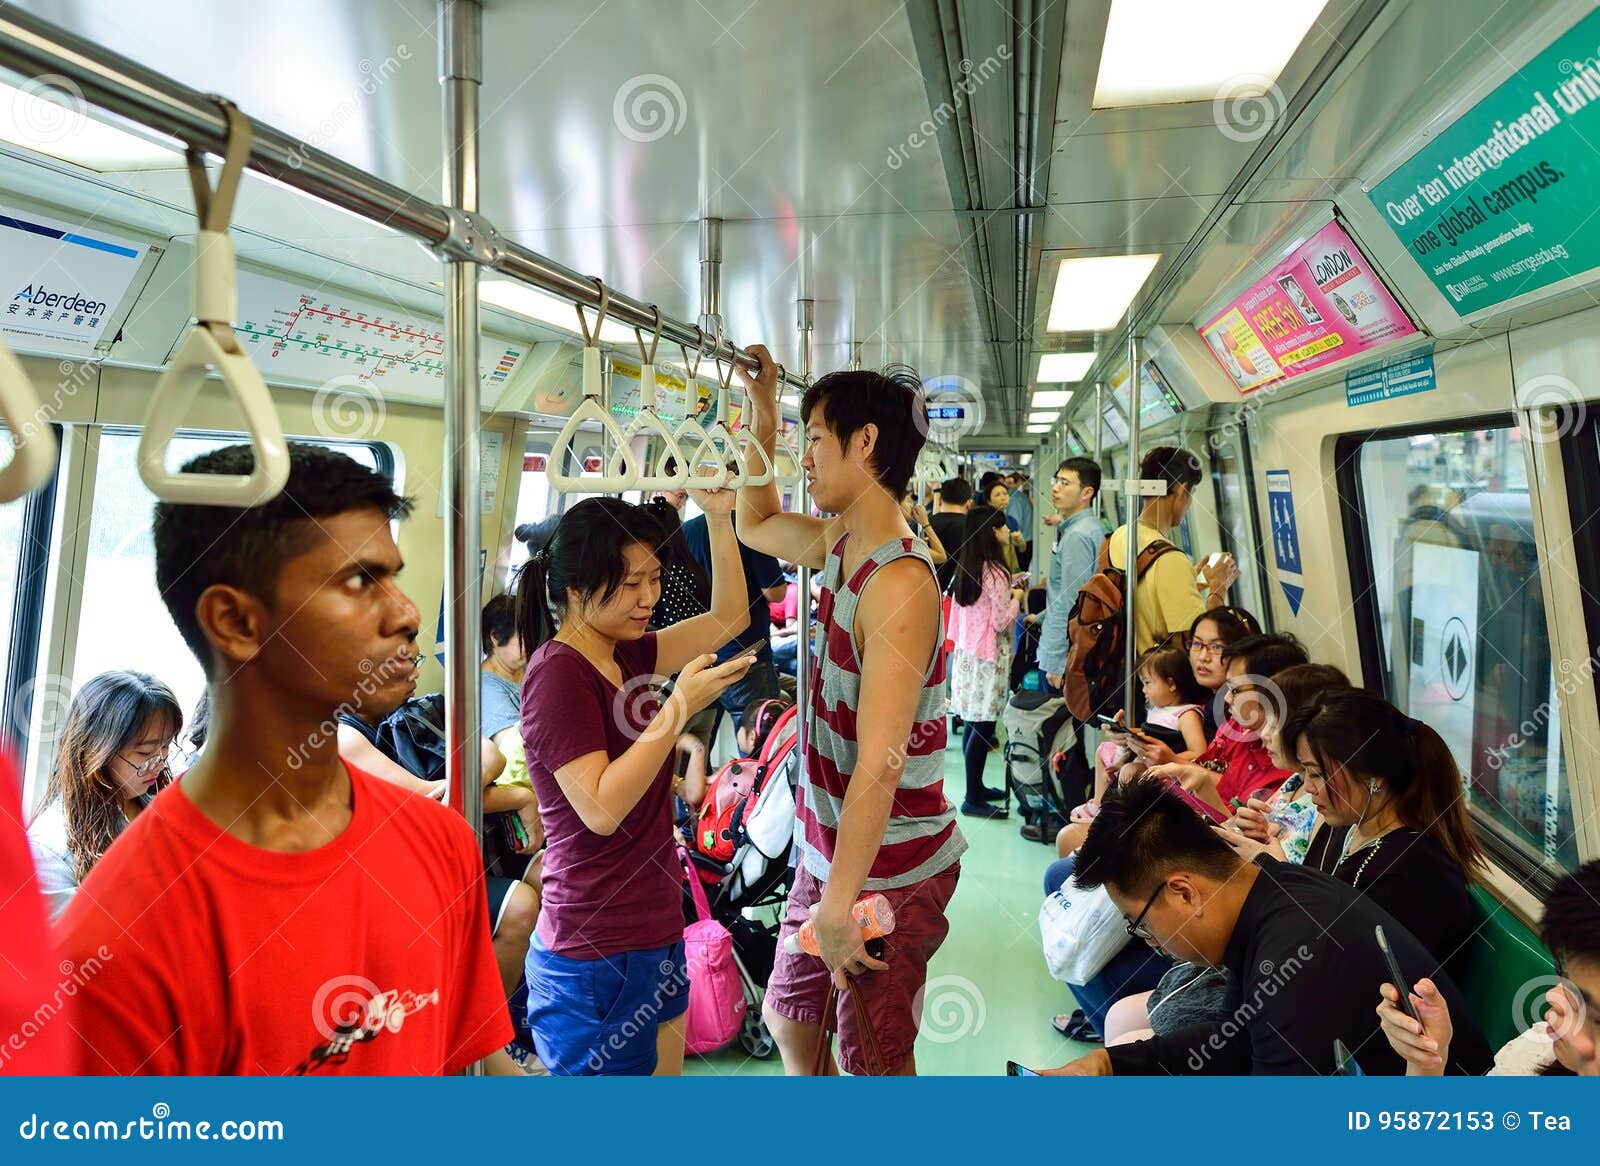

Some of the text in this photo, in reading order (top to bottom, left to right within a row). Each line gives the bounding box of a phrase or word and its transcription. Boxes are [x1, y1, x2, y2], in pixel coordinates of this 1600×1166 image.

[1386, 194, 1424, 226] Over
[1417, 177, 1450, 206] ten
[1437, 91, 1560, 190] international
[1412, 161, 1565, 255] one global campus.
[14, 284, 106, 316] Aberdeen
[1303, 249, 1352, 286] LONDON
